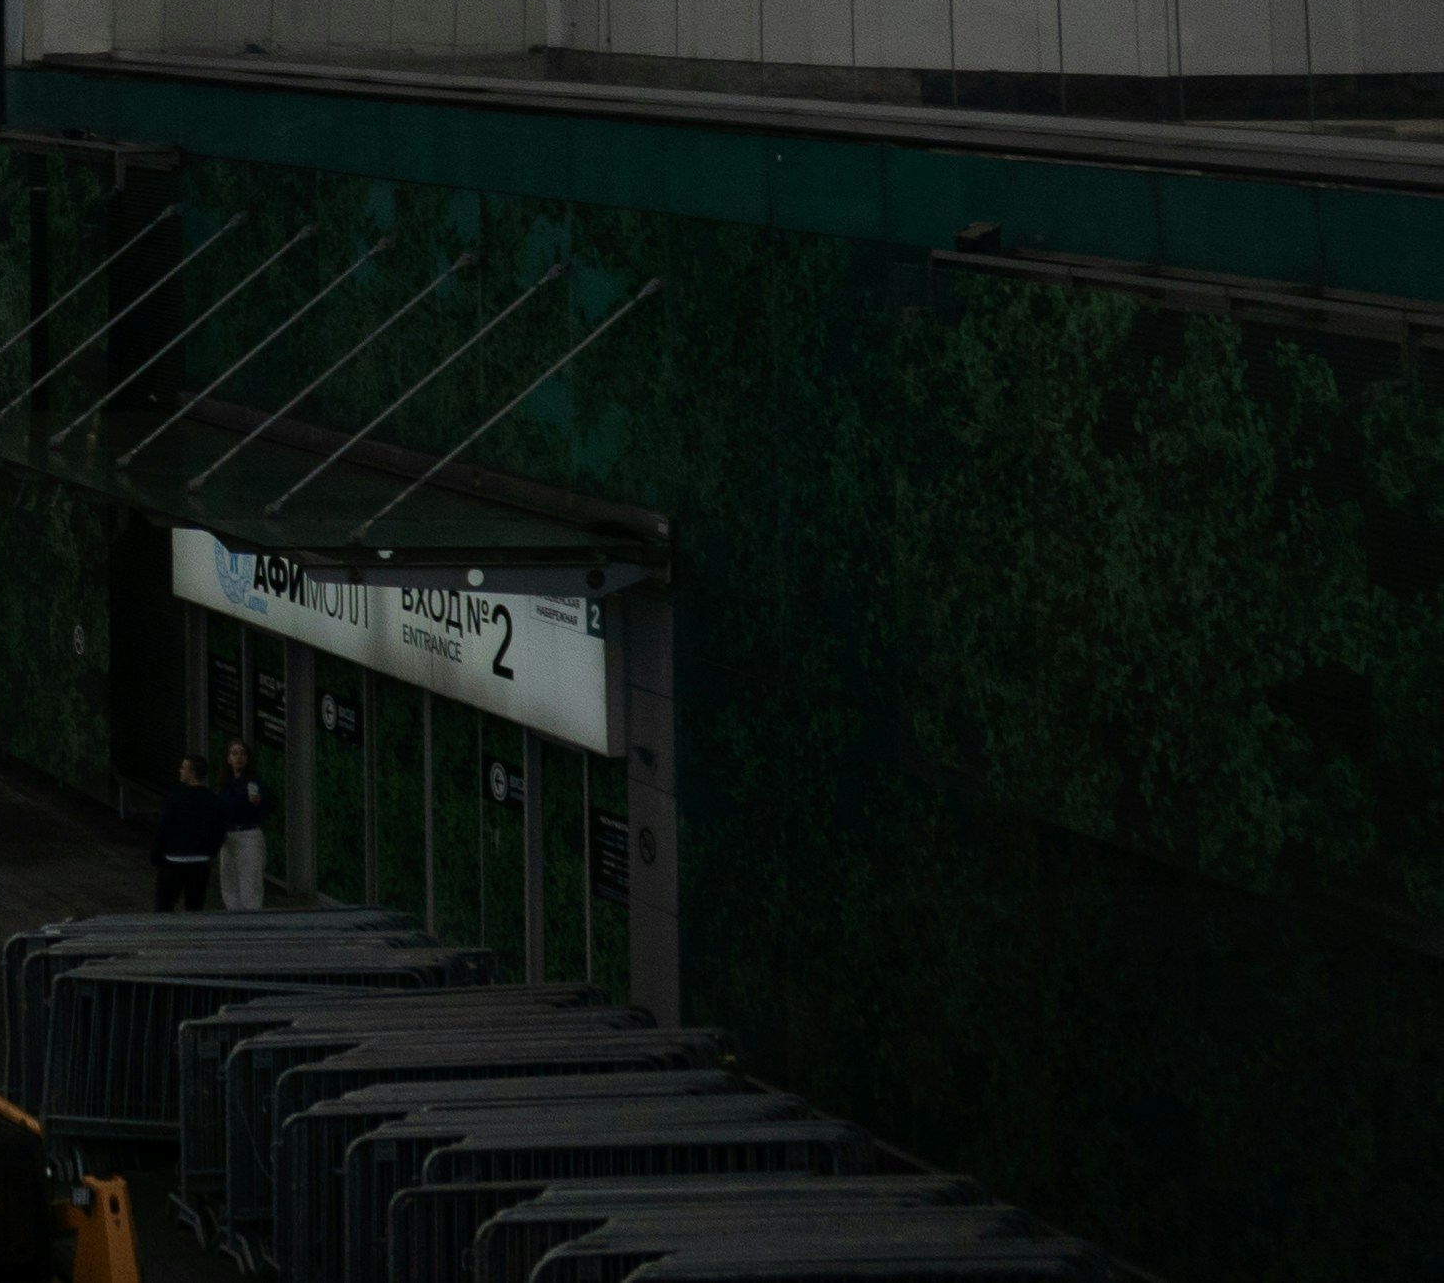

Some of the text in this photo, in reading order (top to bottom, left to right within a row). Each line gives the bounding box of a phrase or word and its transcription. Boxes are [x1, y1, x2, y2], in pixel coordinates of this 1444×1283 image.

[401, 586, 464, 639] ВХОД
[589, 602, 601, 630] 2
[402, 624, 463, 664] ENTRANCE
